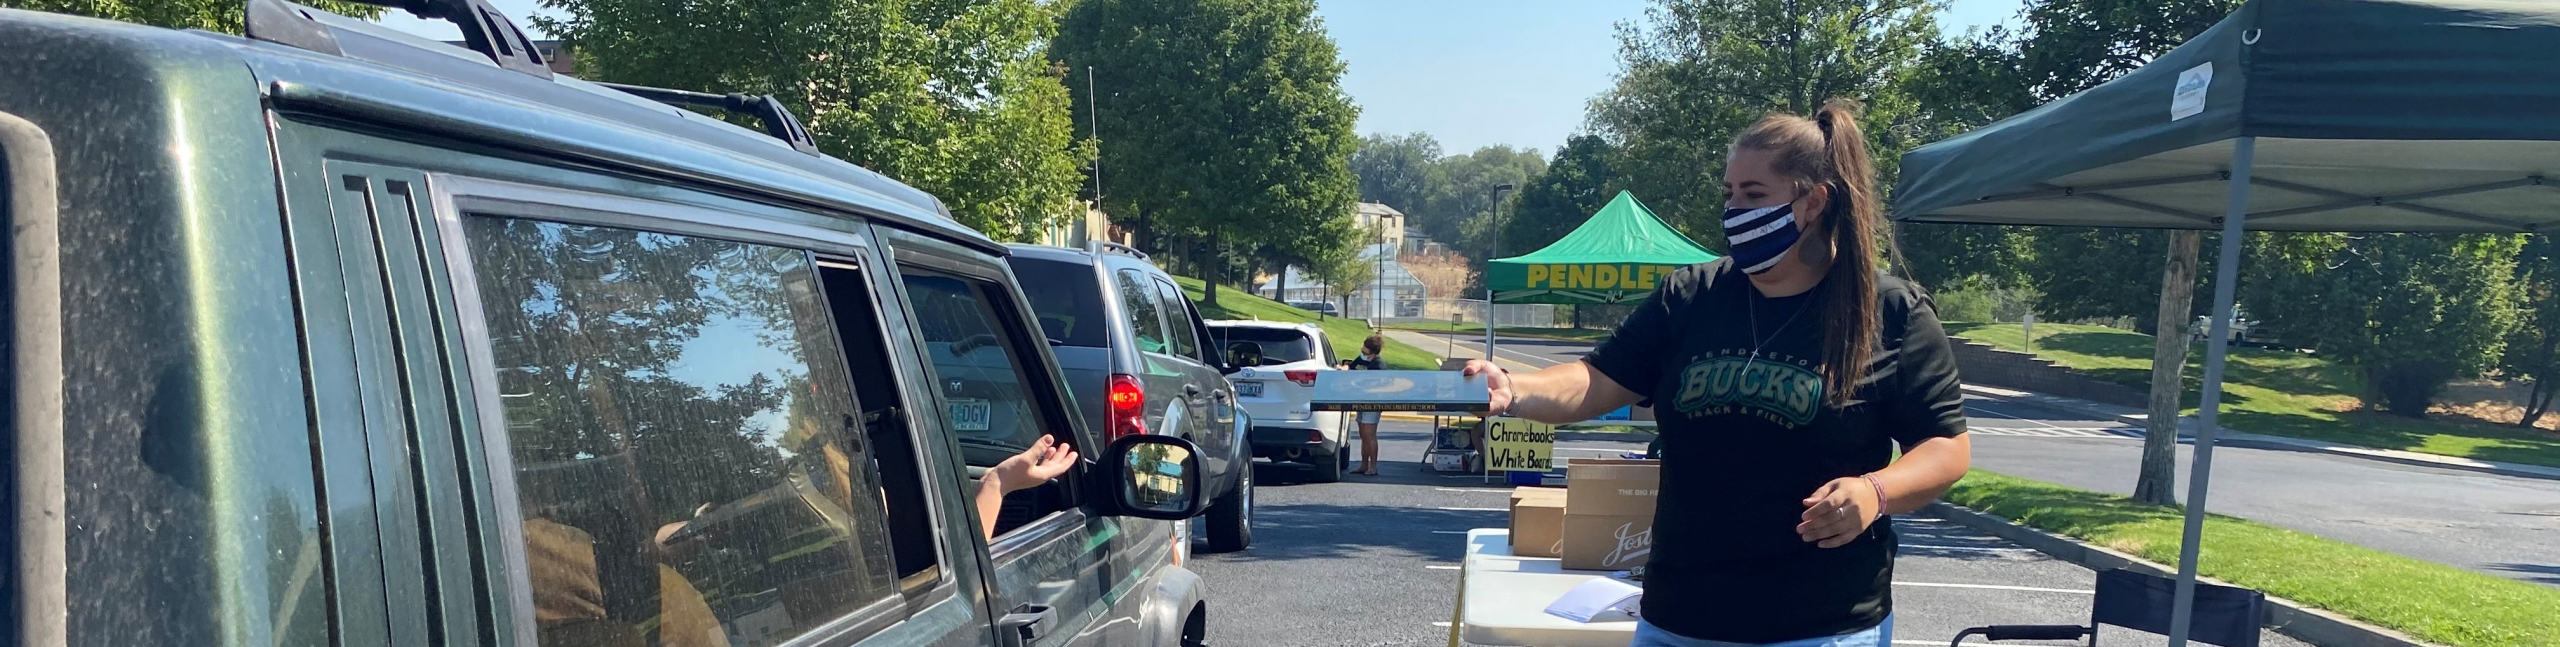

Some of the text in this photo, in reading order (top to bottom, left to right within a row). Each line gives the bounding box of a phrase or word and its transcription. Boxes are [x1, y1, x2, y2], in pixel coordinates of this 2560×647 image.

[1680, 360, 1816, 415] BUCKS
[962, 405, 988, 422] DGV
[1687, 405, 1795, 430] TRACK & FIELD
[1490, 422, 1555, 443] Chromebooks
[1490, 446, 1553, 469] White Boards
[1618, 488, 1633, 496] THE
[1635, 488, 1648, 496] BIG
